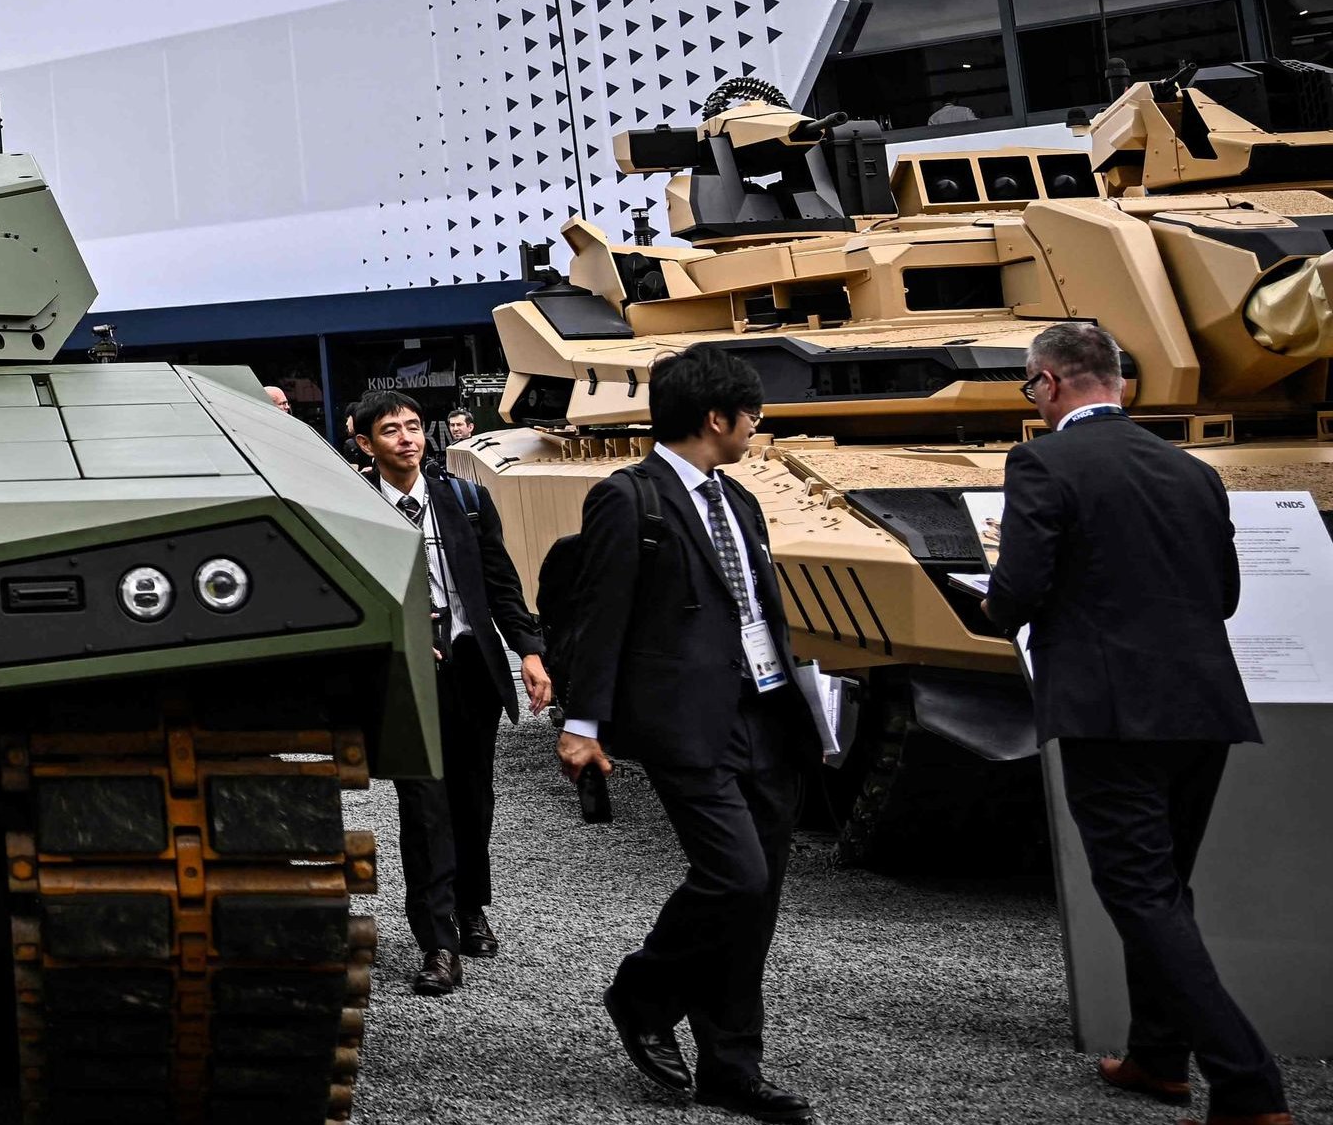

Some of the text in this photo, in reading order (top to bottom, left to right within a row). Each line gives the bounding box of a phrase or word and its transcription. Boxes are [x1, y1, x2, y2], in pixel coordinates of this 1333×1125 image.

[367, 377, 403, 390] KNDS
[1071, 409, 1094, 422] KNDS
[1275, 500, 1306, 509] KNDS
